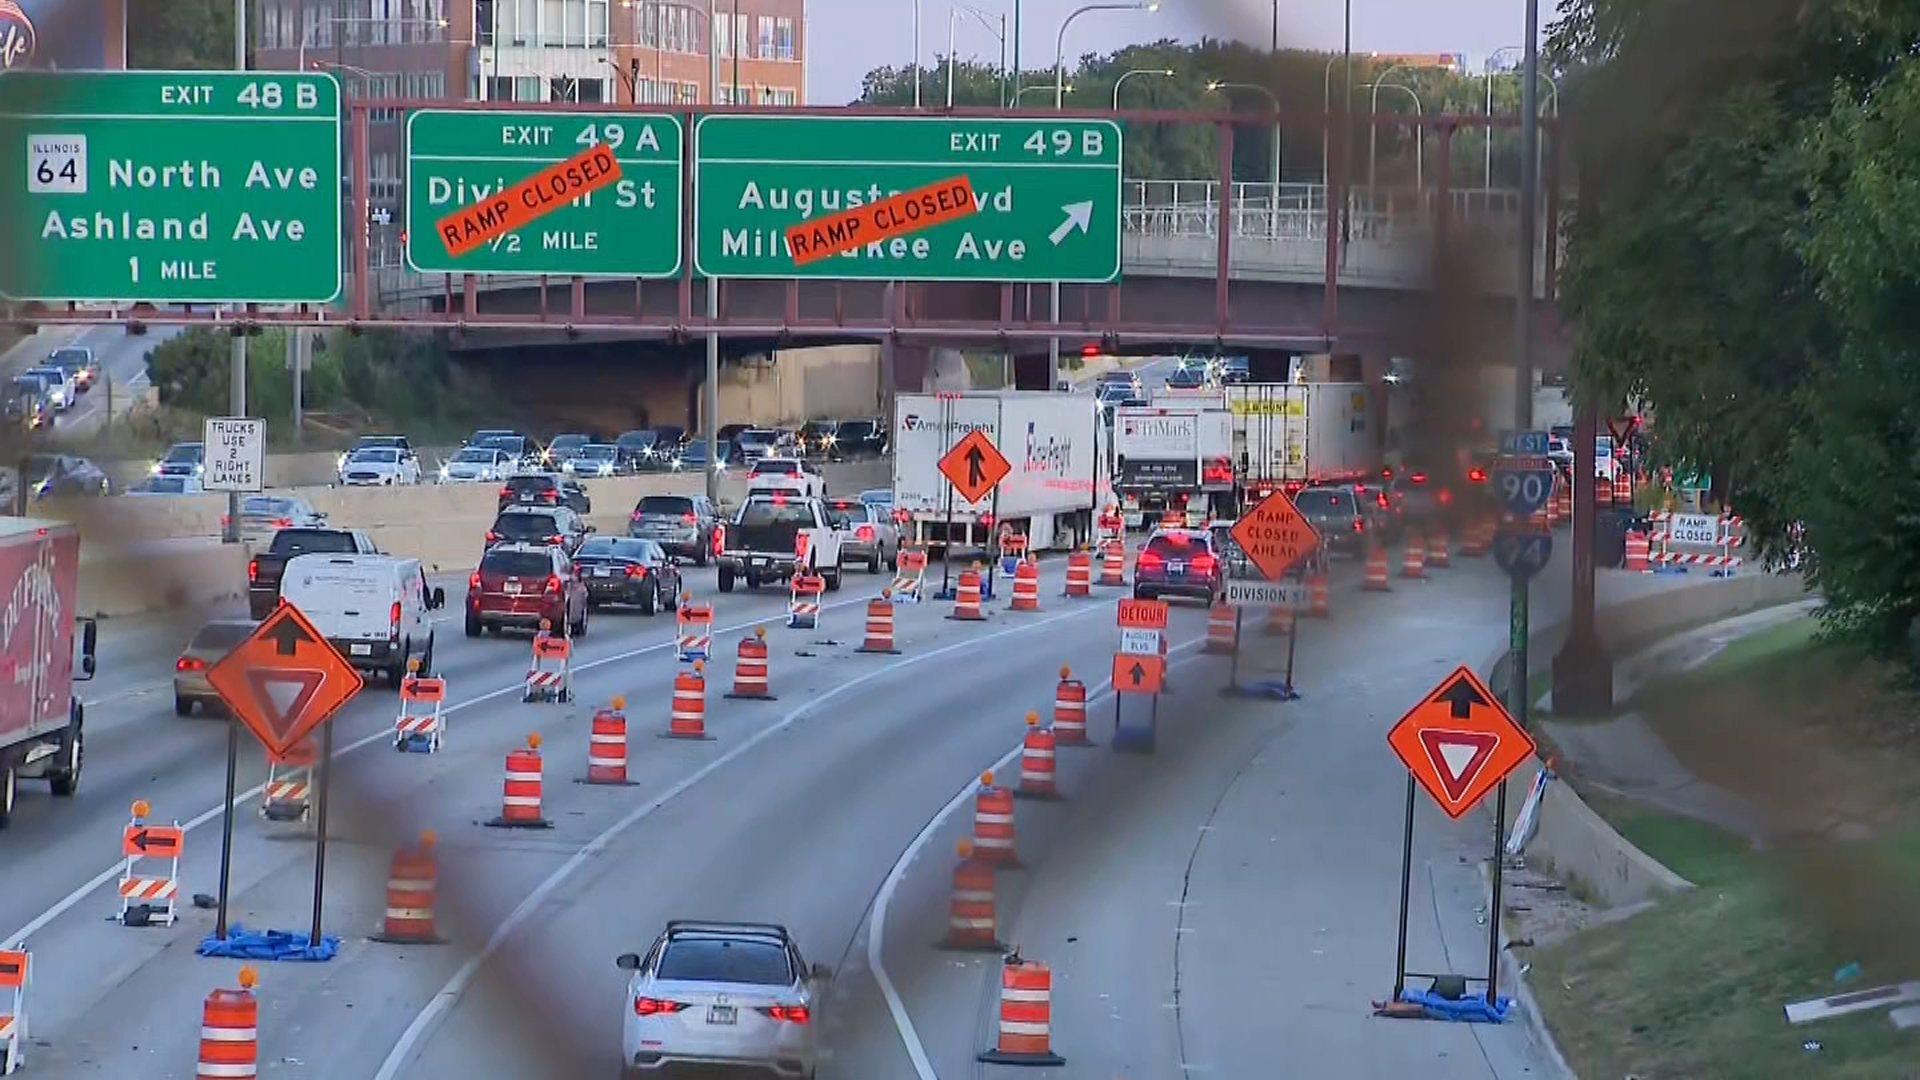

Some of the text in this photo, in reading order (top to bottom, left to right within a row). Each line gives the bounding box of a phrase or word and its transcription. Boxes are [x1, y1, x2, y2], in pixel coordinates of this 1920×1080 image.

[161, 83, 318, 110] EXIT 48 B
[502, 124, 660, 152] EXIT 49 A
[950, 129, 1104, 156] EXIT 49 B
[33, 143, 80, 154] ILLINOIS
[36, 158, 78, 184] 64
[108, 159, 319, 190] North Ave
[428, 176, 656, 209] Divin St
[443, 153, 612, 248] RAMP CLOSED
[738, 181, 903, 219] August
[42, 210, 306, 242] Ashland Ave
[792, 185, 968, 256] RAMP CLOSED
[542, 231, 599, 250] MILE
[722, 227, 1027, 261] Milkee Ave
[128, 256, 218, 283] 1 MILE
[212, 422, 255, 434] TRUCKS
[223, 435, 245, 447] USE
[230, 448, 237, 459] 2
[215, 460, 250, 472] RIGHT
[213, 473, 252, 484] LANES
[1503, 474, 1543, 504] 90
[1257, 511, 1294, 525] RAMP
[1679, 518, 1708, 529] RAMP
[1247, 526, 1299, 544] CLOSED
[1674, 530, 1713, 541] CLOSED
[1251, 544, 1298, 558] AHEAD
[1230, 586, 1287, 602] DIVISION
[1121, 606, 1164, 622] DETOUR
